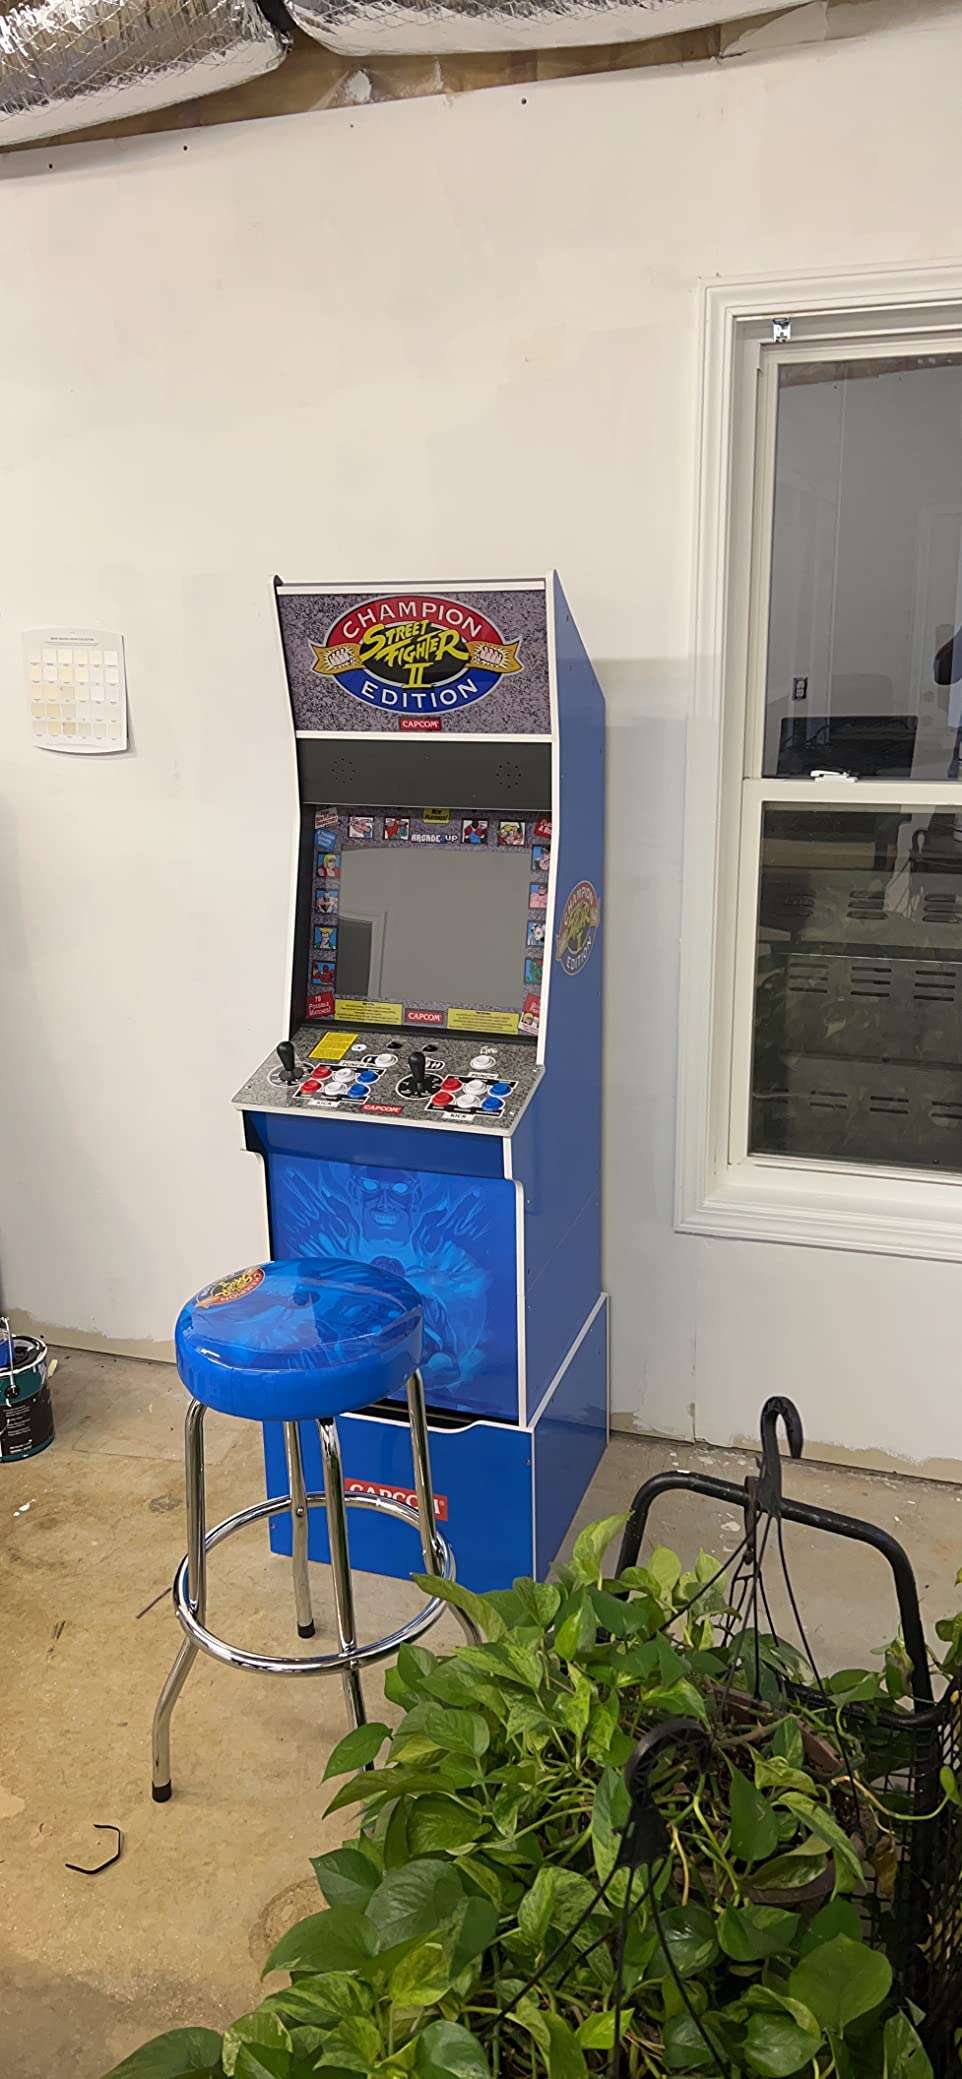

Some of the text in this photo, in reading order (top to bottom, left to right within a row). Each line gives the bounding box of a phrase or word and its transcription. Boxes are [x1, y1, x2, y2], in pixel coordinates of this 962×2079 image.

[342, 601, 482, 639] CHAMPION
[360, 620, 429, 661] STREET
[376, 629, 470, 667] FIGHTER
[402, 662, 433, 689] II
[361, 678, 478, 709] EDITION
[402, 719, 438, 729] CAPCOM
[564, 886, 593, 926] CHAMPION
[566, 936, 592, 970] EDITION
[408, 1012, 441, 1022] CAPCOM
[363, 1104, 398, 1113] CAPCOM
